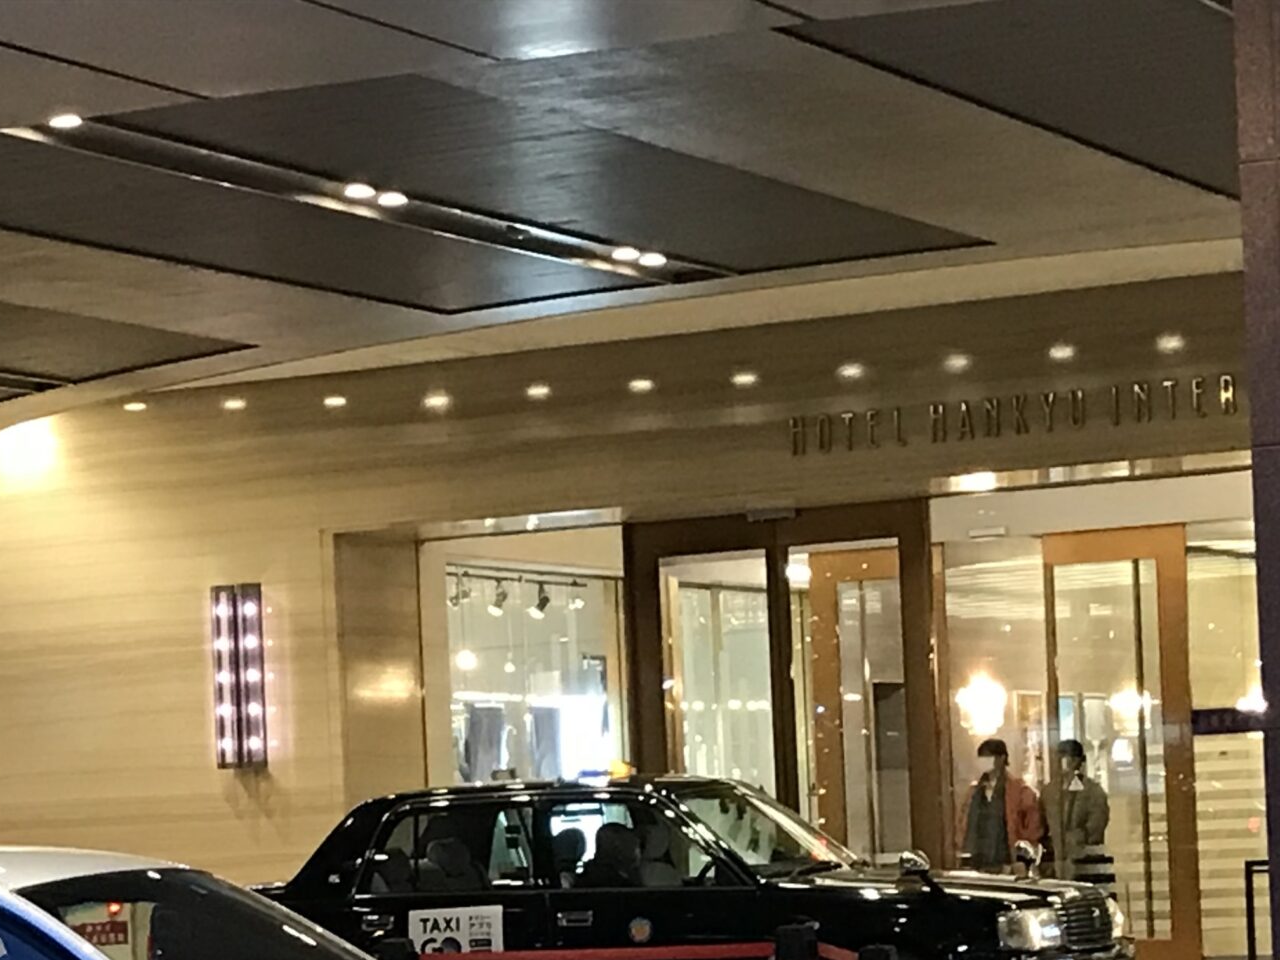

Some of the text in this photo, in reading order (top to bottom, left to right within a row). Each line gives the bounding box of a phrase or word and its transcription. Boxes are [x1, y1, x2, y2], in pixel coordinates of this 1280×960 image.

[789, 374, 1238, 456] HOTEL HANKYU INTER
[419, 916, 461, 934] TAXI
[421, 937, 462, 954] GO
